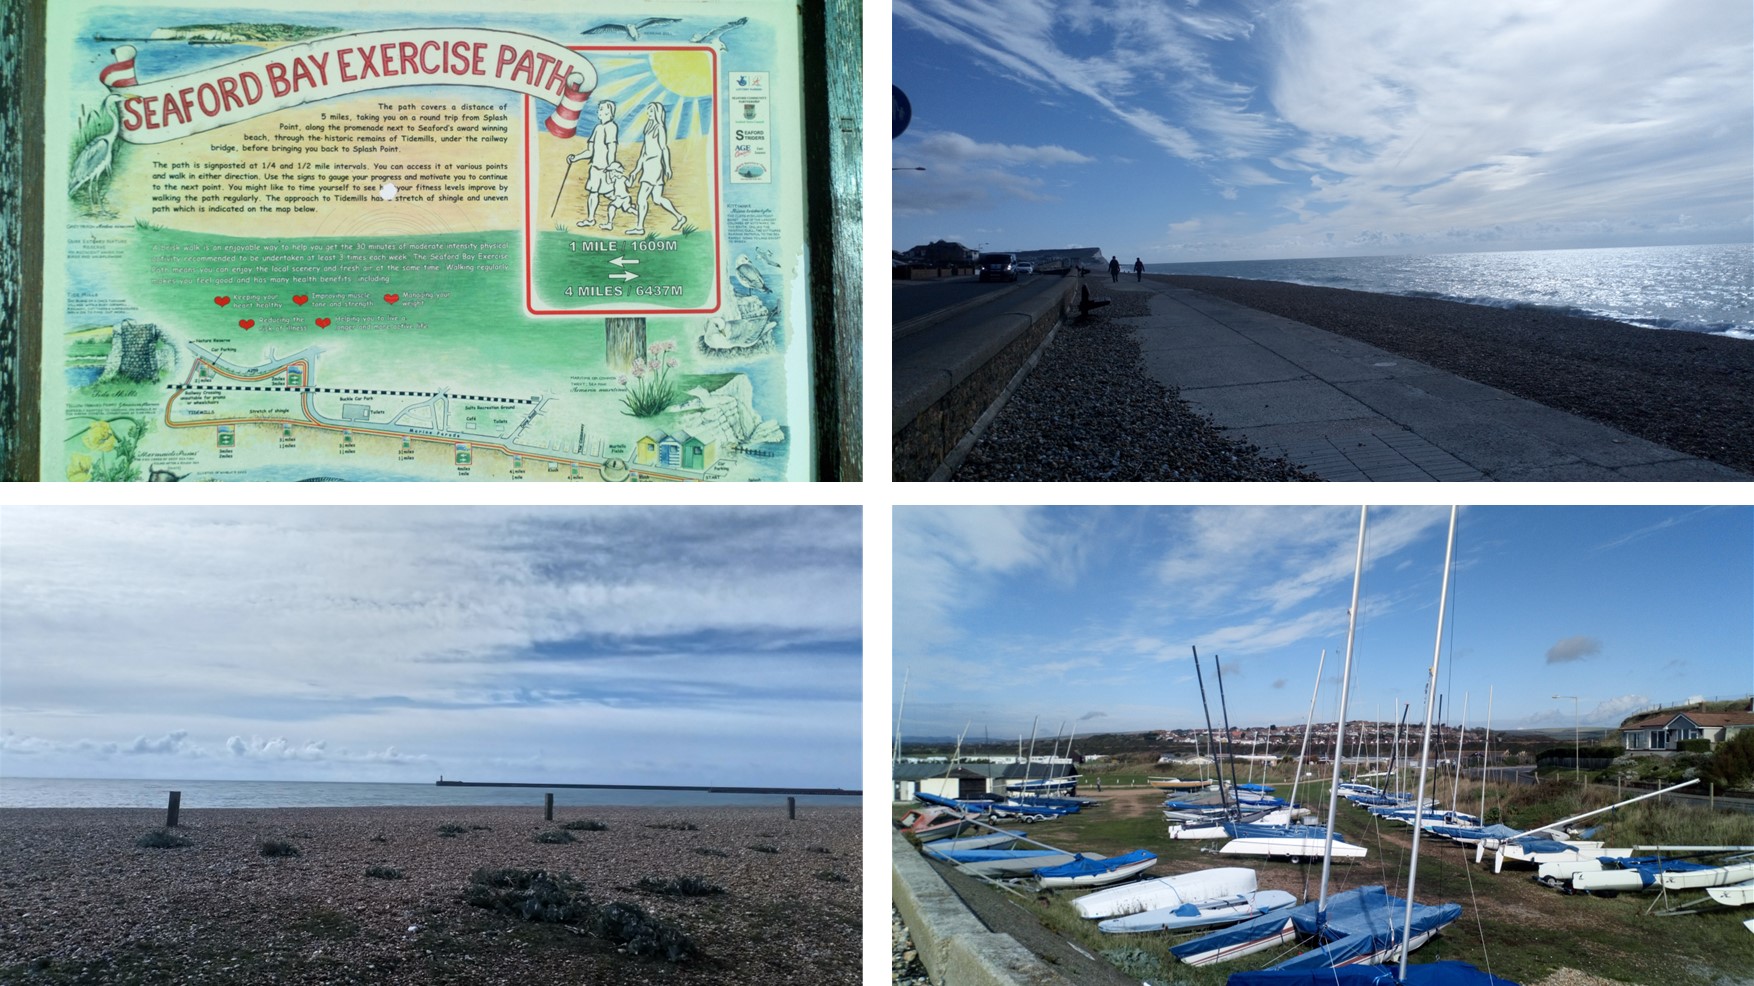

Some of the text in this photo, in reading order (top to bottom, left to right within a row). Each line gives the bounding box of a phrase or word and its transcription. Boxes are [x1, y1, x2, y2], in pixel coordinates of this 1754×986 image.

[123, 40, 574, 131] SEAFORD BAY EXERCISE PATH
[398, 104, 416, 112] path
[330, 113, 352, 121] miles,
[356, 114, 380, 122] taking
[444, 114, 459, 122] trip
[483, 114, 508, 122] Splash
[279, 123, 302, 131] Point,
[305, 124, 325, 132] along
[344, 124, 384, 132] promenade
[418, 124, 454, 132] Seaford's
[482, 125, 508, 133] winning
[244, 134, 270, 142] beach,
[274, 134, 304, 143] through
[324, 134, 353, 142] historic
[401, 135, 437, 143] Tidemills,
[481, 135, 508, 144] railway
[210, 144, 238, 153] bridge,
[242, 144, 268, 152] before
[272, 145, 302, 154] bringing
[352, 146, 378, 154] Splash
[171, 162, 190, 170] path
[204, 162, 246, 170] signposted
[314, 162, 330, 170] mile
[486, 163, 508, 171] points
[198, 172, 222, 180] either
[297, 174, 315, 182] signs
[202, 184, 224, 192] point.
[245, 184, 267, 192] might
[318, 184, 349, 192] yourself
[468, 184, 496, 192] improve
[499, 184, 508, 192] by
[152, 194, 181, 203] walking
[201, 194, 220, 203] path
[223, 194, 261, 203] regularly.
[265, 194, 280, 202] The
[284, 195, 319, 203] approach
[334, 194, 368, 202] Tidemills
[395, 194, 424, 202] stretch
[426, 194, 435, 202] of
[438, 194, 464, 203] shingle
[152, 205, 170, 214] path
[569, 241, 576, 251] 1
[582, 241, 617, 251] MILE
[631, 241, 677, 251] 1609M
[462, 252, 476, 261] Bay
[478, 252, 508, 260] Exercise
[564, 286, 573, 296] 4
[578, 286, 623, 296] MILES
[636, 286, 683, 296] 6437M
